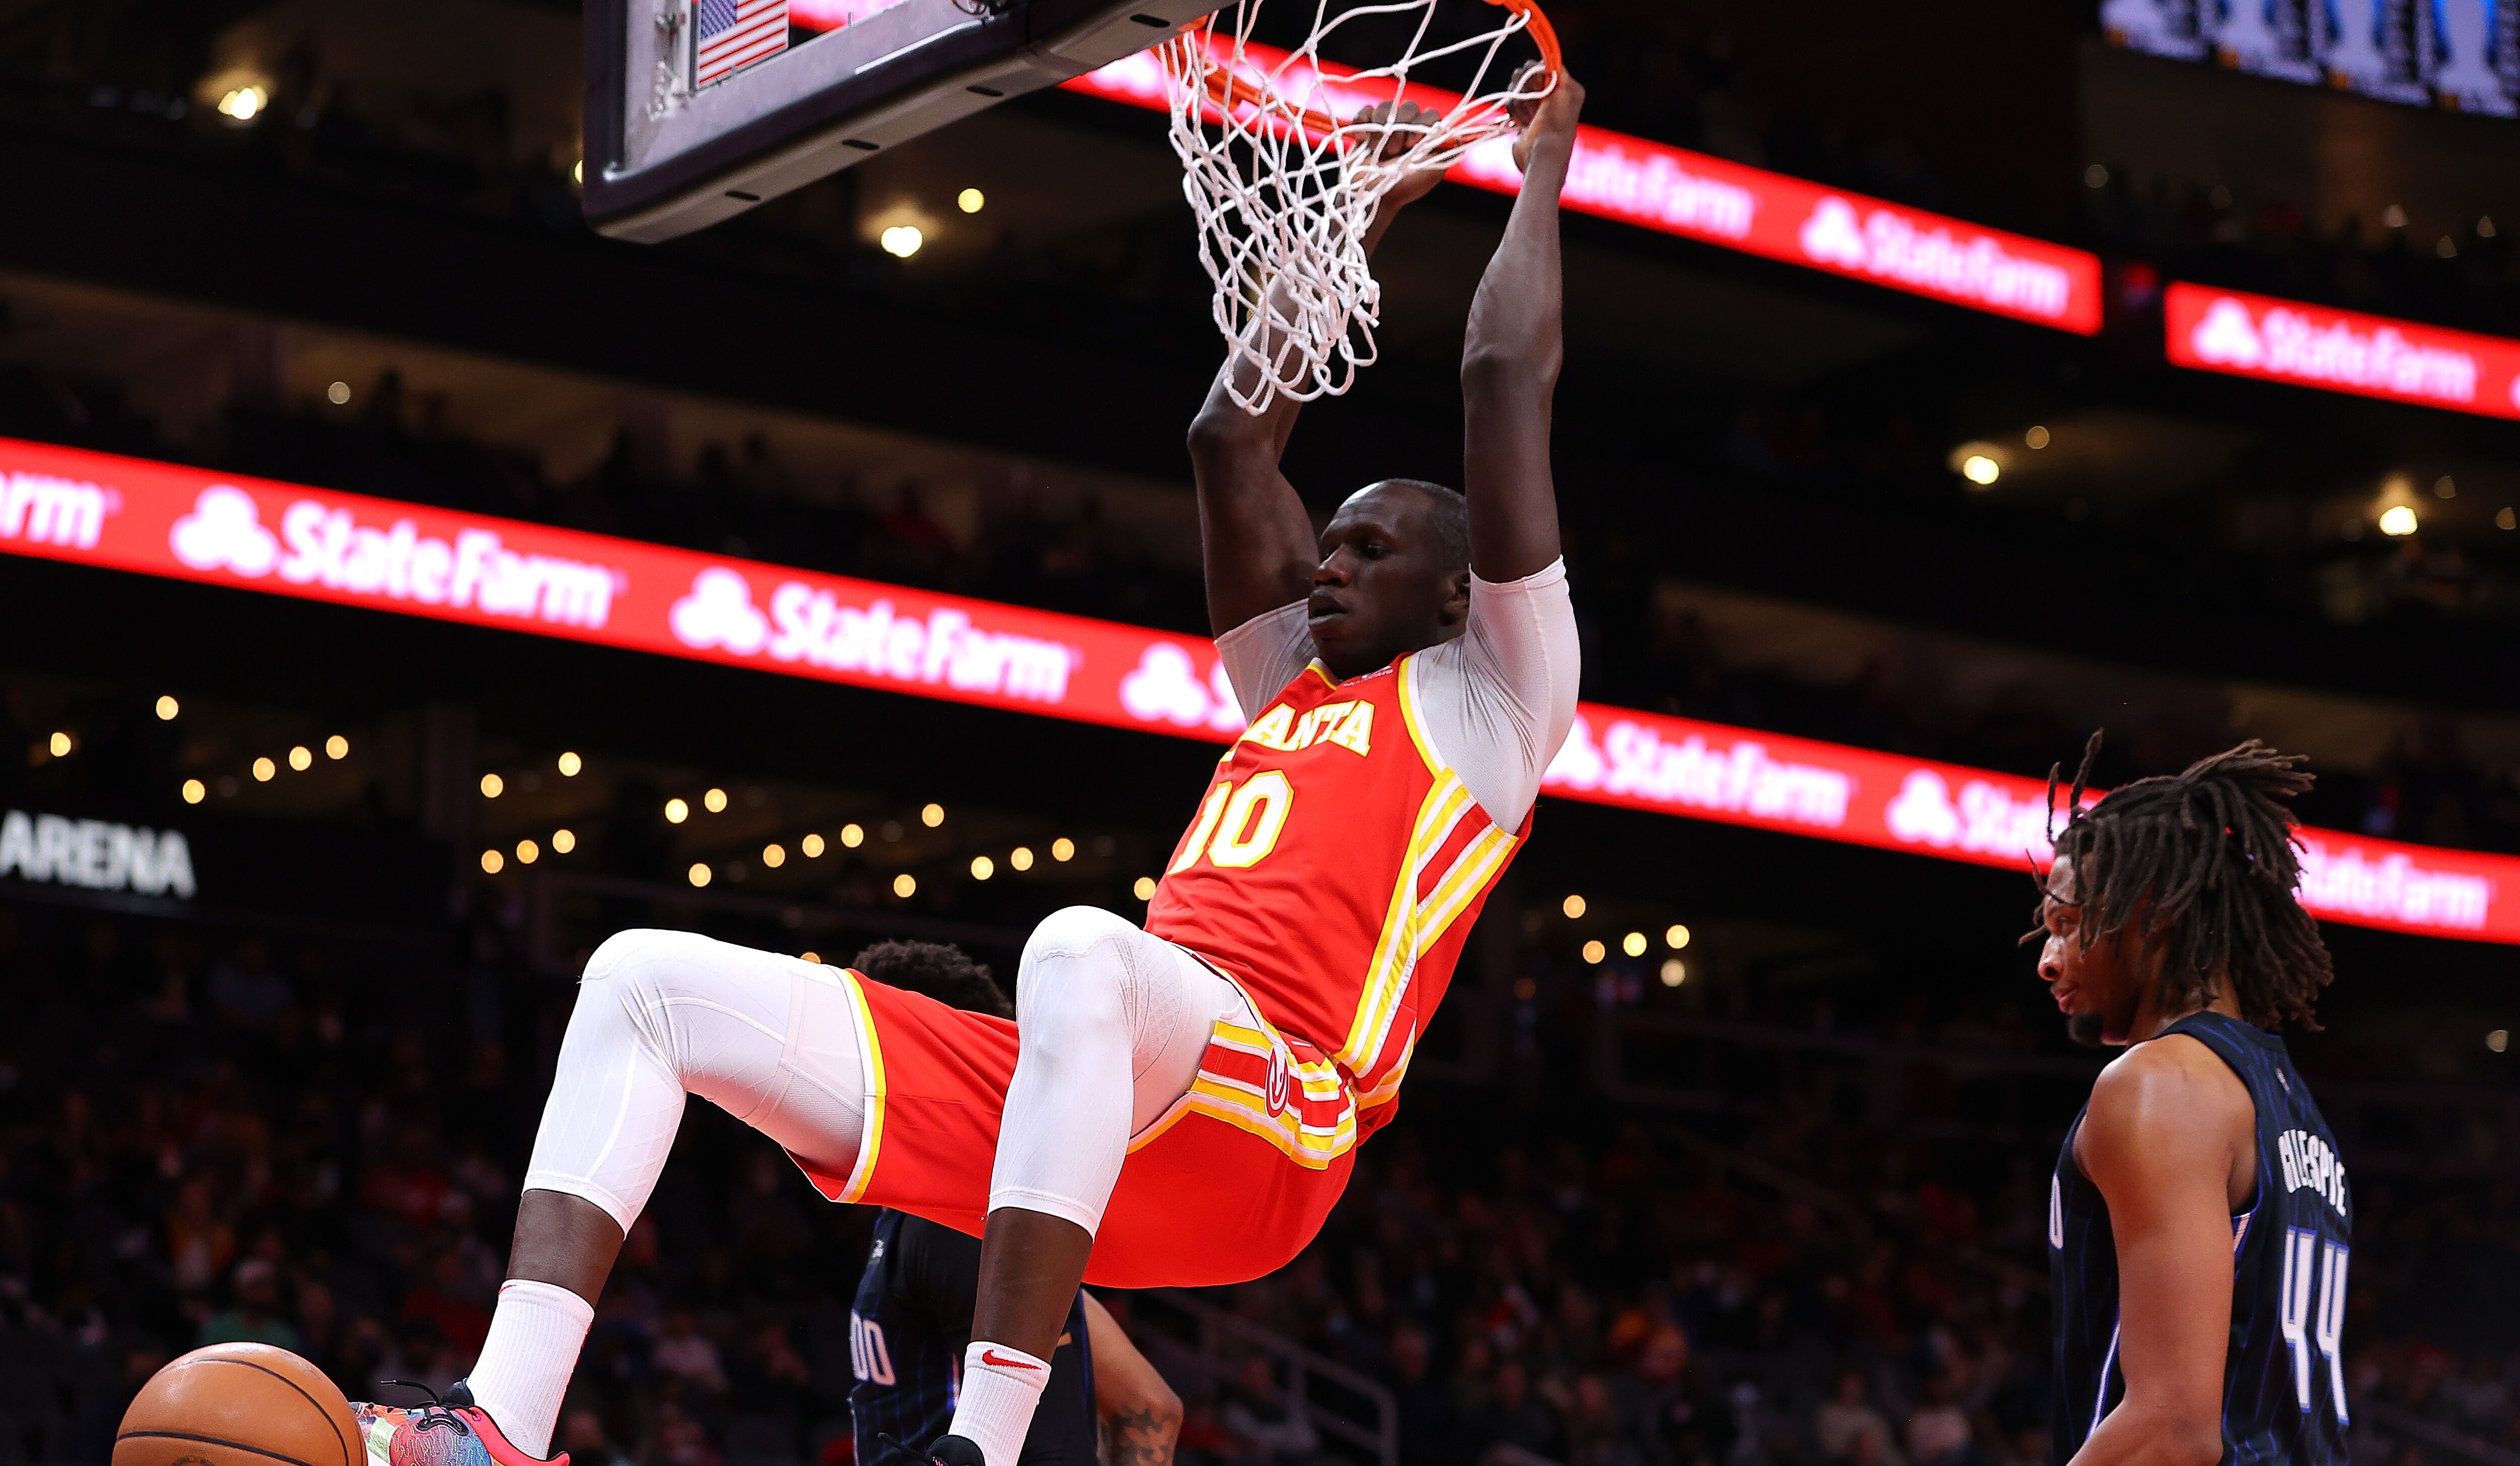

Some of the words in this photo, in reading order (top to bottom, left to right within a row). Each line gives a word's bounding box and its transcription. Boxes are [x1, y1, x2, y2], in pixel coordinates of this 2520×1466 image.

[1220, 699, 1375, 757] ANTA
[0, 809, 198, 899] ARENA
[1167, 770, 1294, 875] 10
[2281, 1225, 2351, 1426] 44
